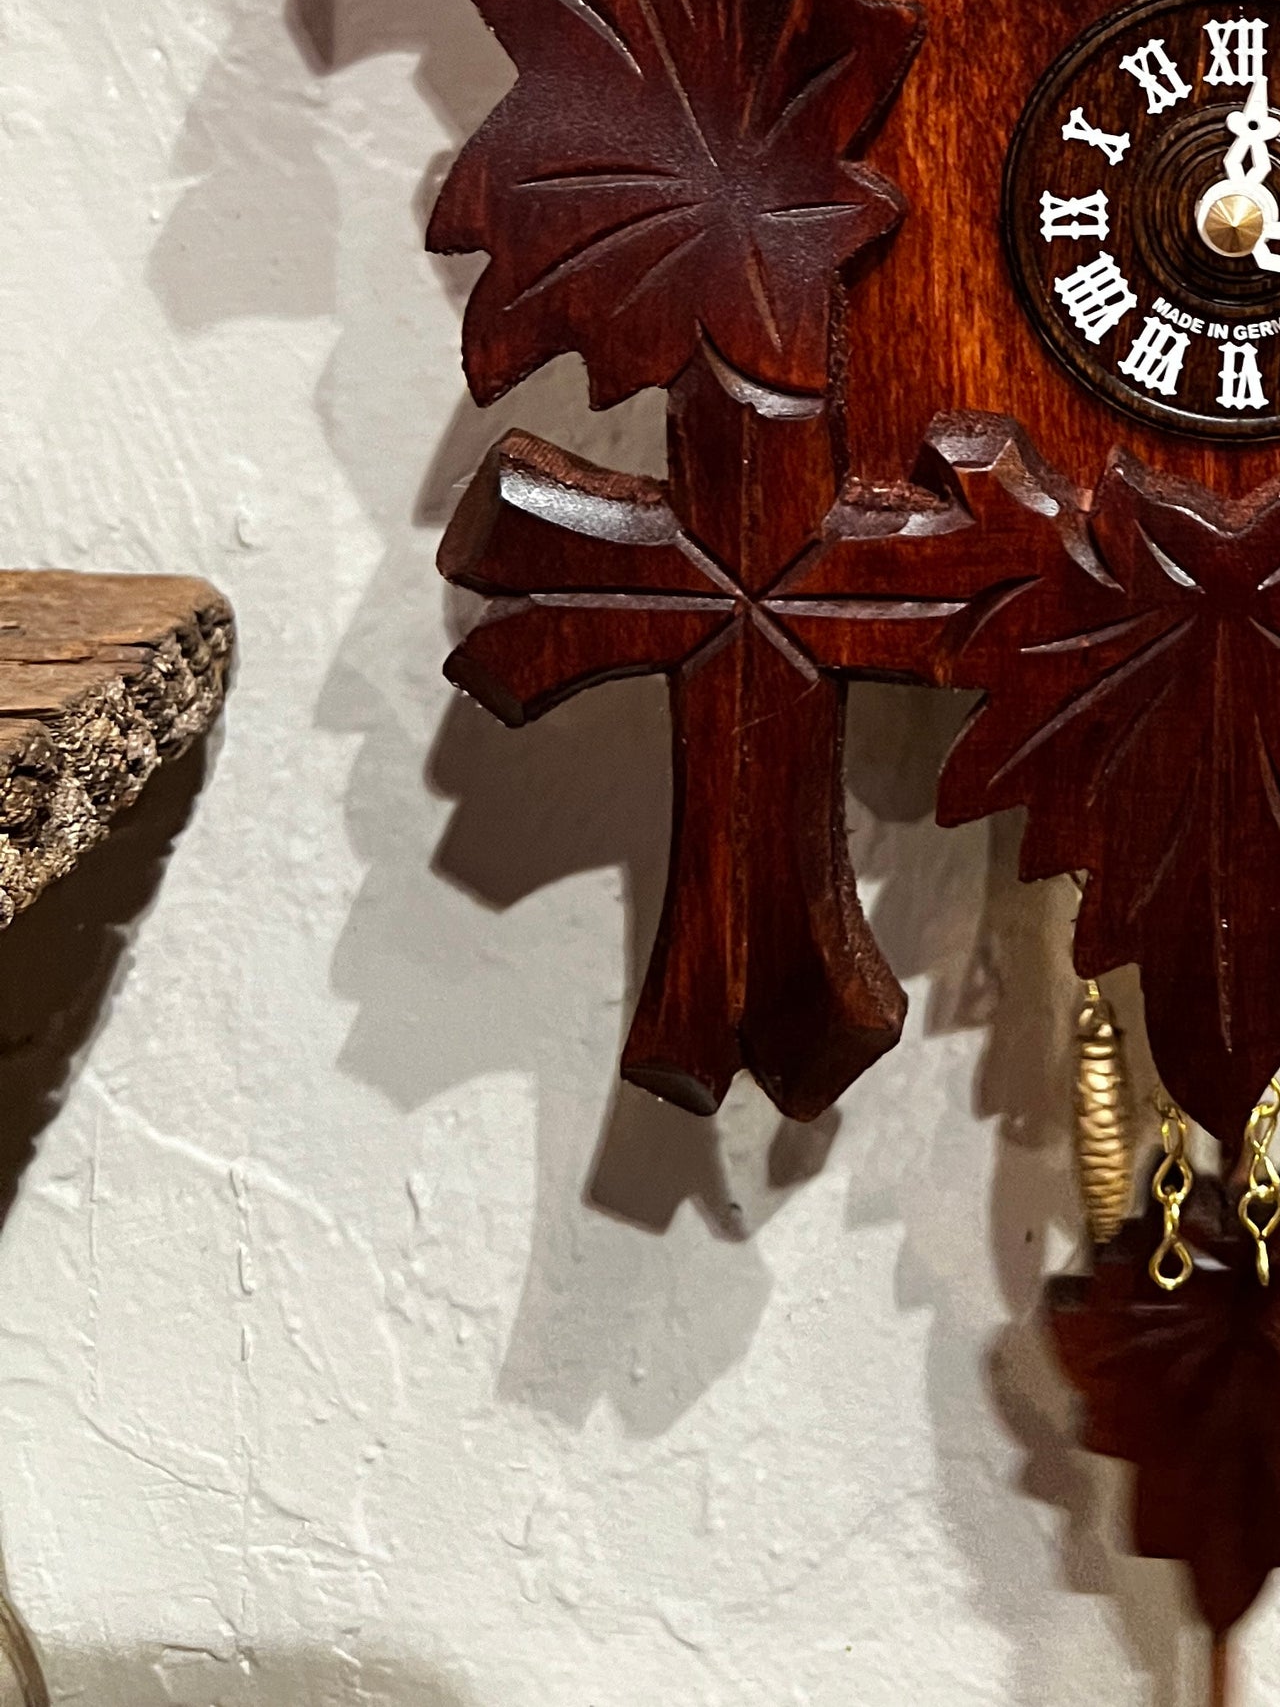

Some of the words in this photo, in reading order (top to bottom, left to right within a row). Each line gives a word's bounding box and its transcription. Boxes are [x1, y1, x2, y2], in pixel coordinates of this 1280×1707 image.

[1119, 39, 1192, 114] XI
[1202, 18, 1269, 86] XII
[1062, 107, 1130, 165] X
[1040, 189, 1109, 242] IX
[1152, 297, 1205, 334] MADE
[1207, 323, 1229, 340] IN
[1216, 342, 1269, 410] VI
